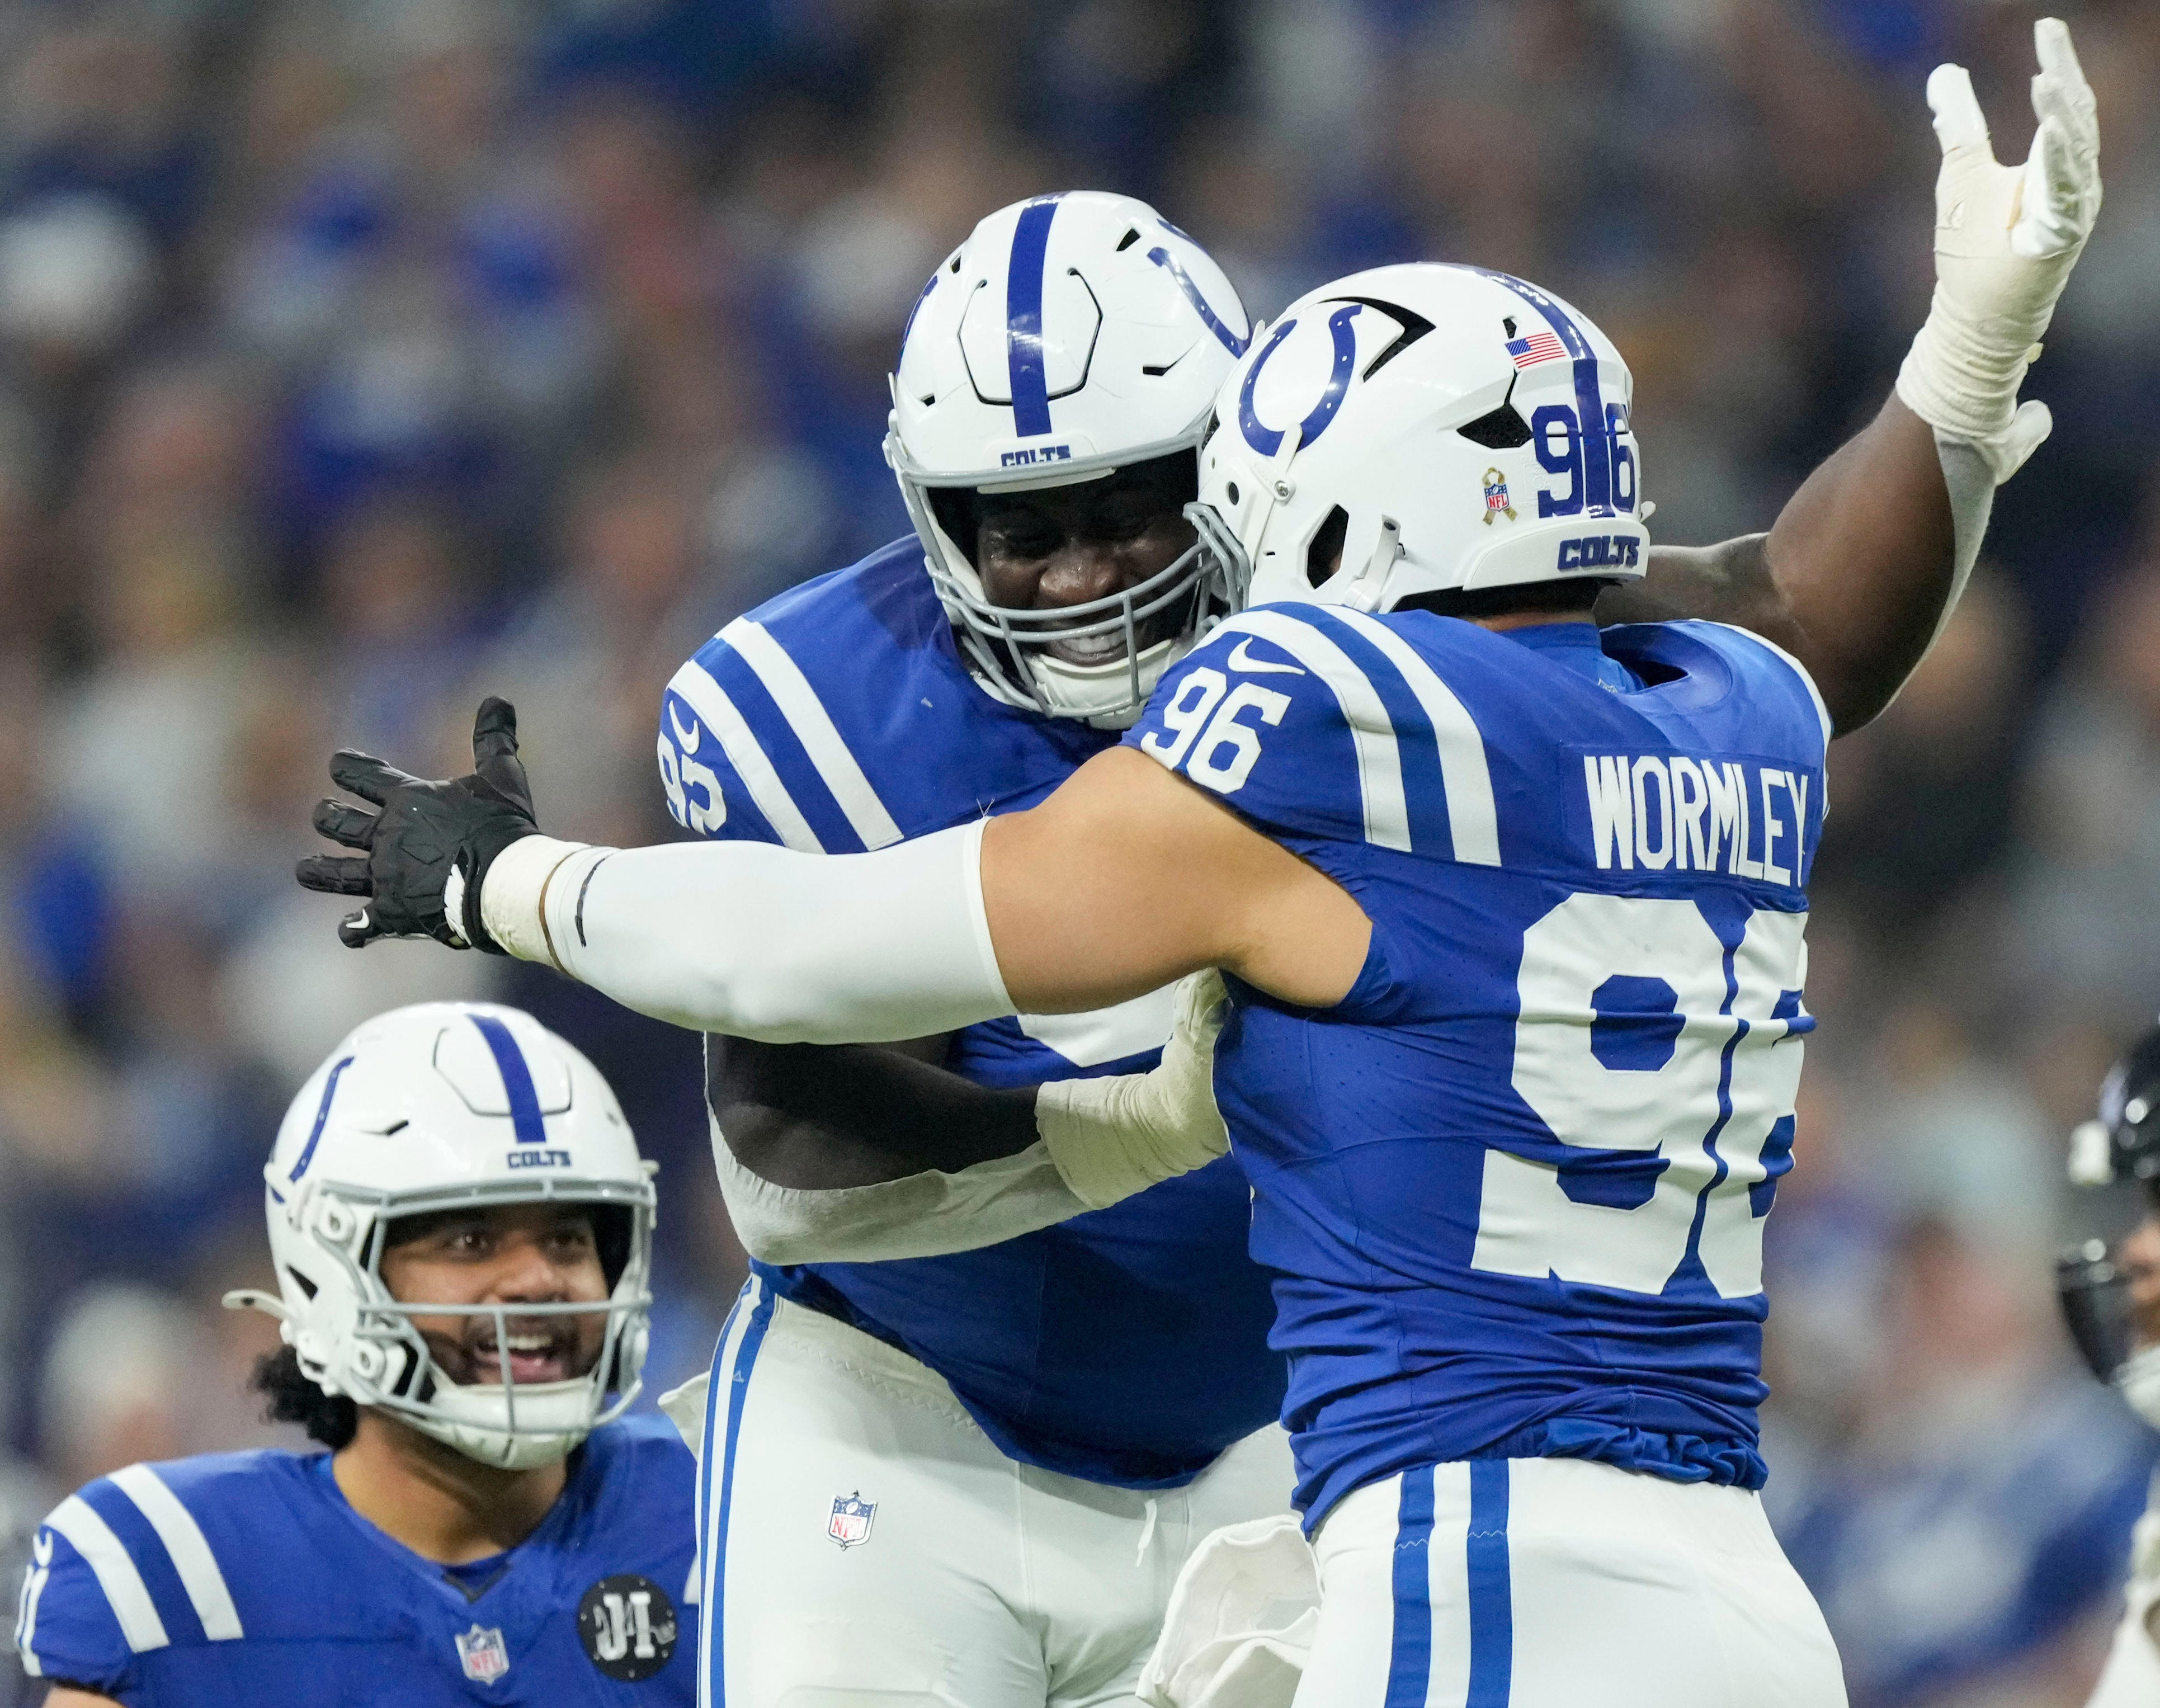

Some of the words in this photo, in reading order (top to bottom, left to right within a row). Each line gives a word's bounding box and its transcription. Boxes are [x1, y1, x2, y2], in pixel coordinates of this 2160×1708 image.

[1001, 445, 1071, 466] COLTS
[1531, 403, 1635, 518] 96
[1488, 494, 1507, 508] NFL
[1558, 535, 1640, 572] COLTS
[1141, 666, 1292, 794] 96
[1584, 755, 1809, 888] WORMLEY
[1470, 892, 1810, 1299] 96
[508, 1150, 570, 1168] COLTS
